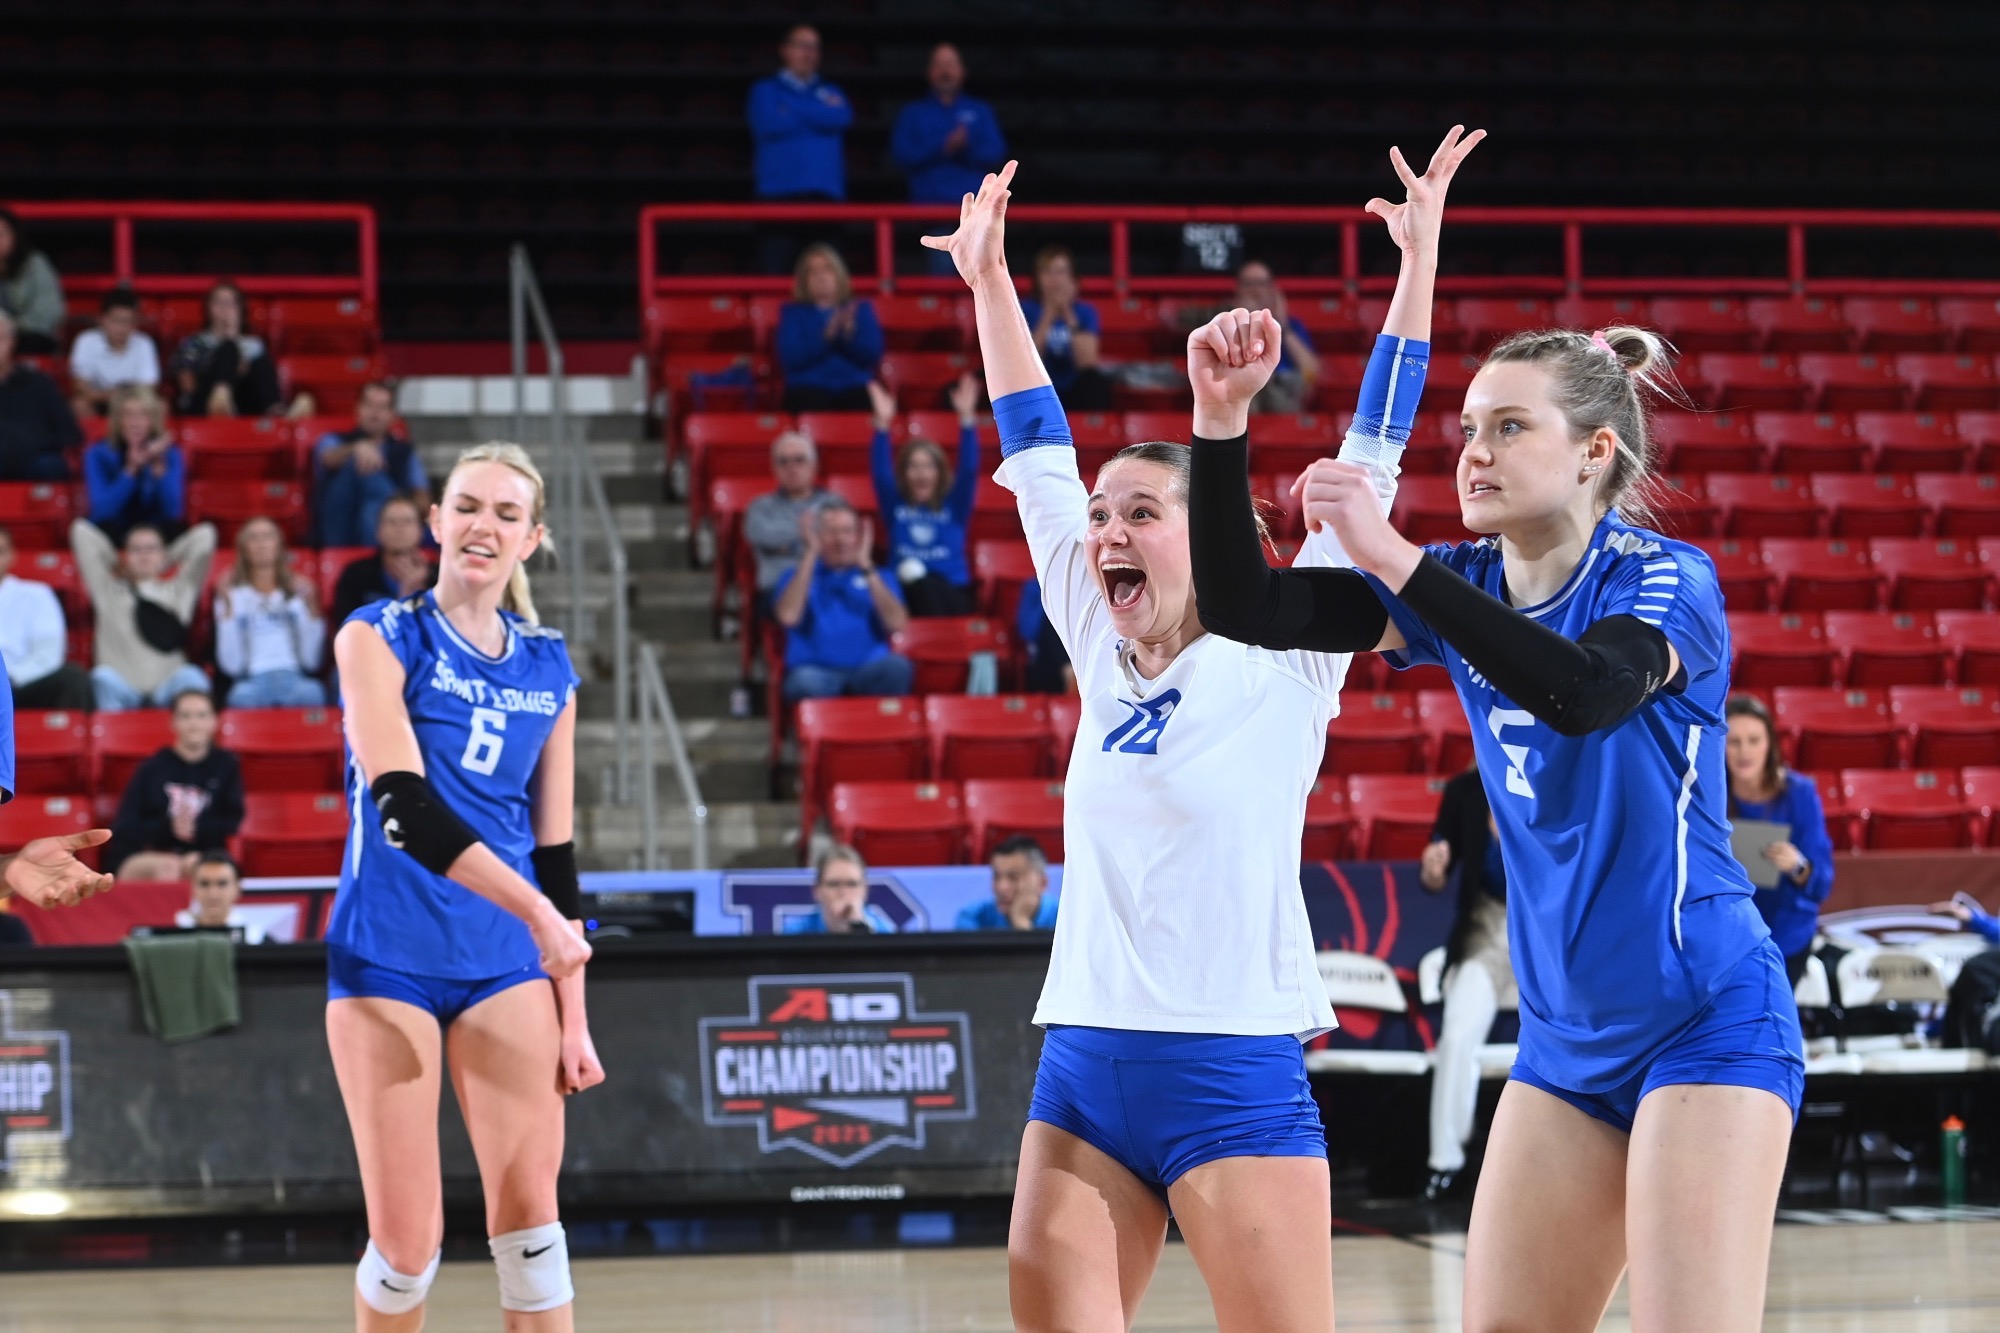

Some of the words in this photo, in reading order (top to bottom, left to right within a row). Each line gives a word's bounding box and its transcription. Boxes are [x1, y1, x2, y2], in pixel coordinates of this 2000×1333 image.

[431, 658, 486, 704] SAINT
[489, 687, 557, 716] LOUIS
[460, 706, 506, 776] 6
[1102, 688, 1181, 755] 18
[1488, 705, 1536, 799] 5
[767, 988, 900, 1023] A10
[715, 1043, 957, 1096] CHAMPIONSHIP
